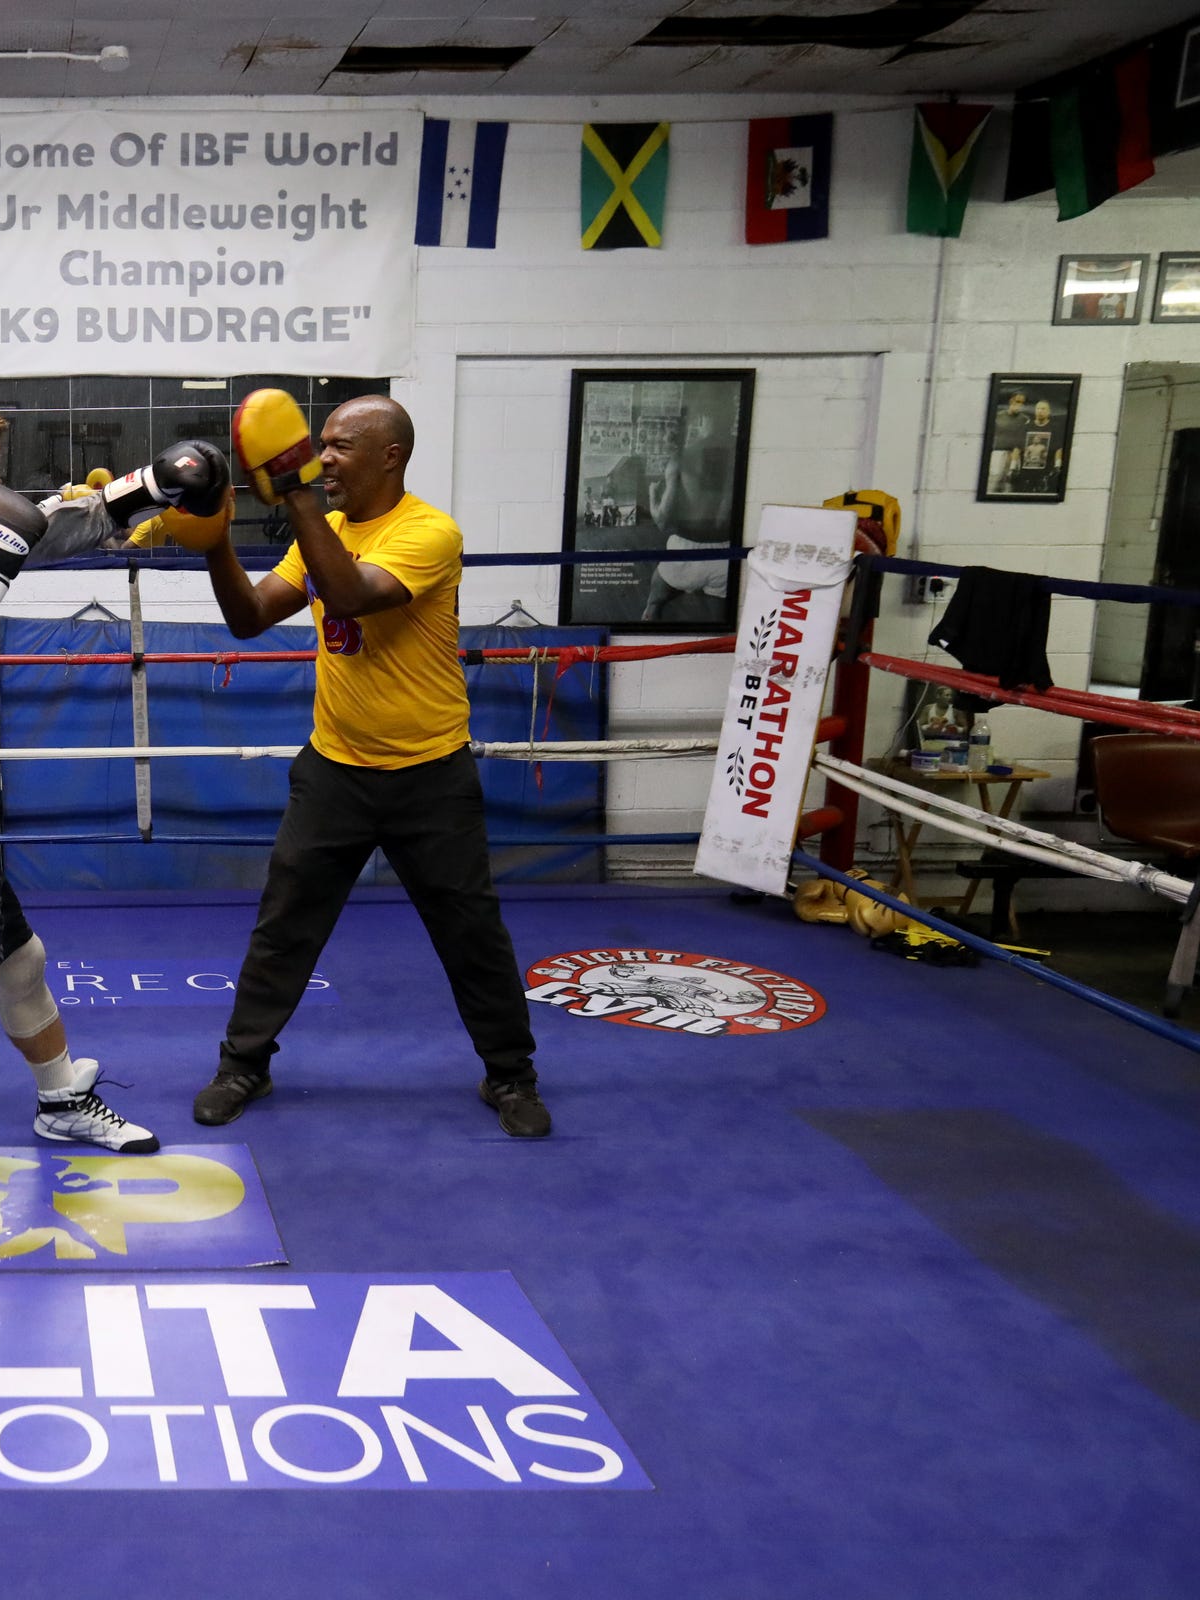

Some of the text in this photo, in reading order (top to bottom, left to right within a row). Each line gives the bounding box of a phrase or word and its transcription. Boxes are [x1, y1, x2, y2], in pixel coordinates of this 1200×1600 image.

[109, 131, 168, 168] Of
[180, 131, 249, 167] IBF
[264, 130, 399, 167] World
[57, 189, 369, 242] Middleweight
[59, 246, 285, 297] Champion
[76, 305, 371, 344] BUNDRAGE"
[737, 674, 760, 731] BET
[741, 589, 812, 819] MARATHON
[66, 973, 330, 991] REGS
[524, 981, 729, 1035] Gym
[550, 950, 819, 1024] FIGHT FACTORY
